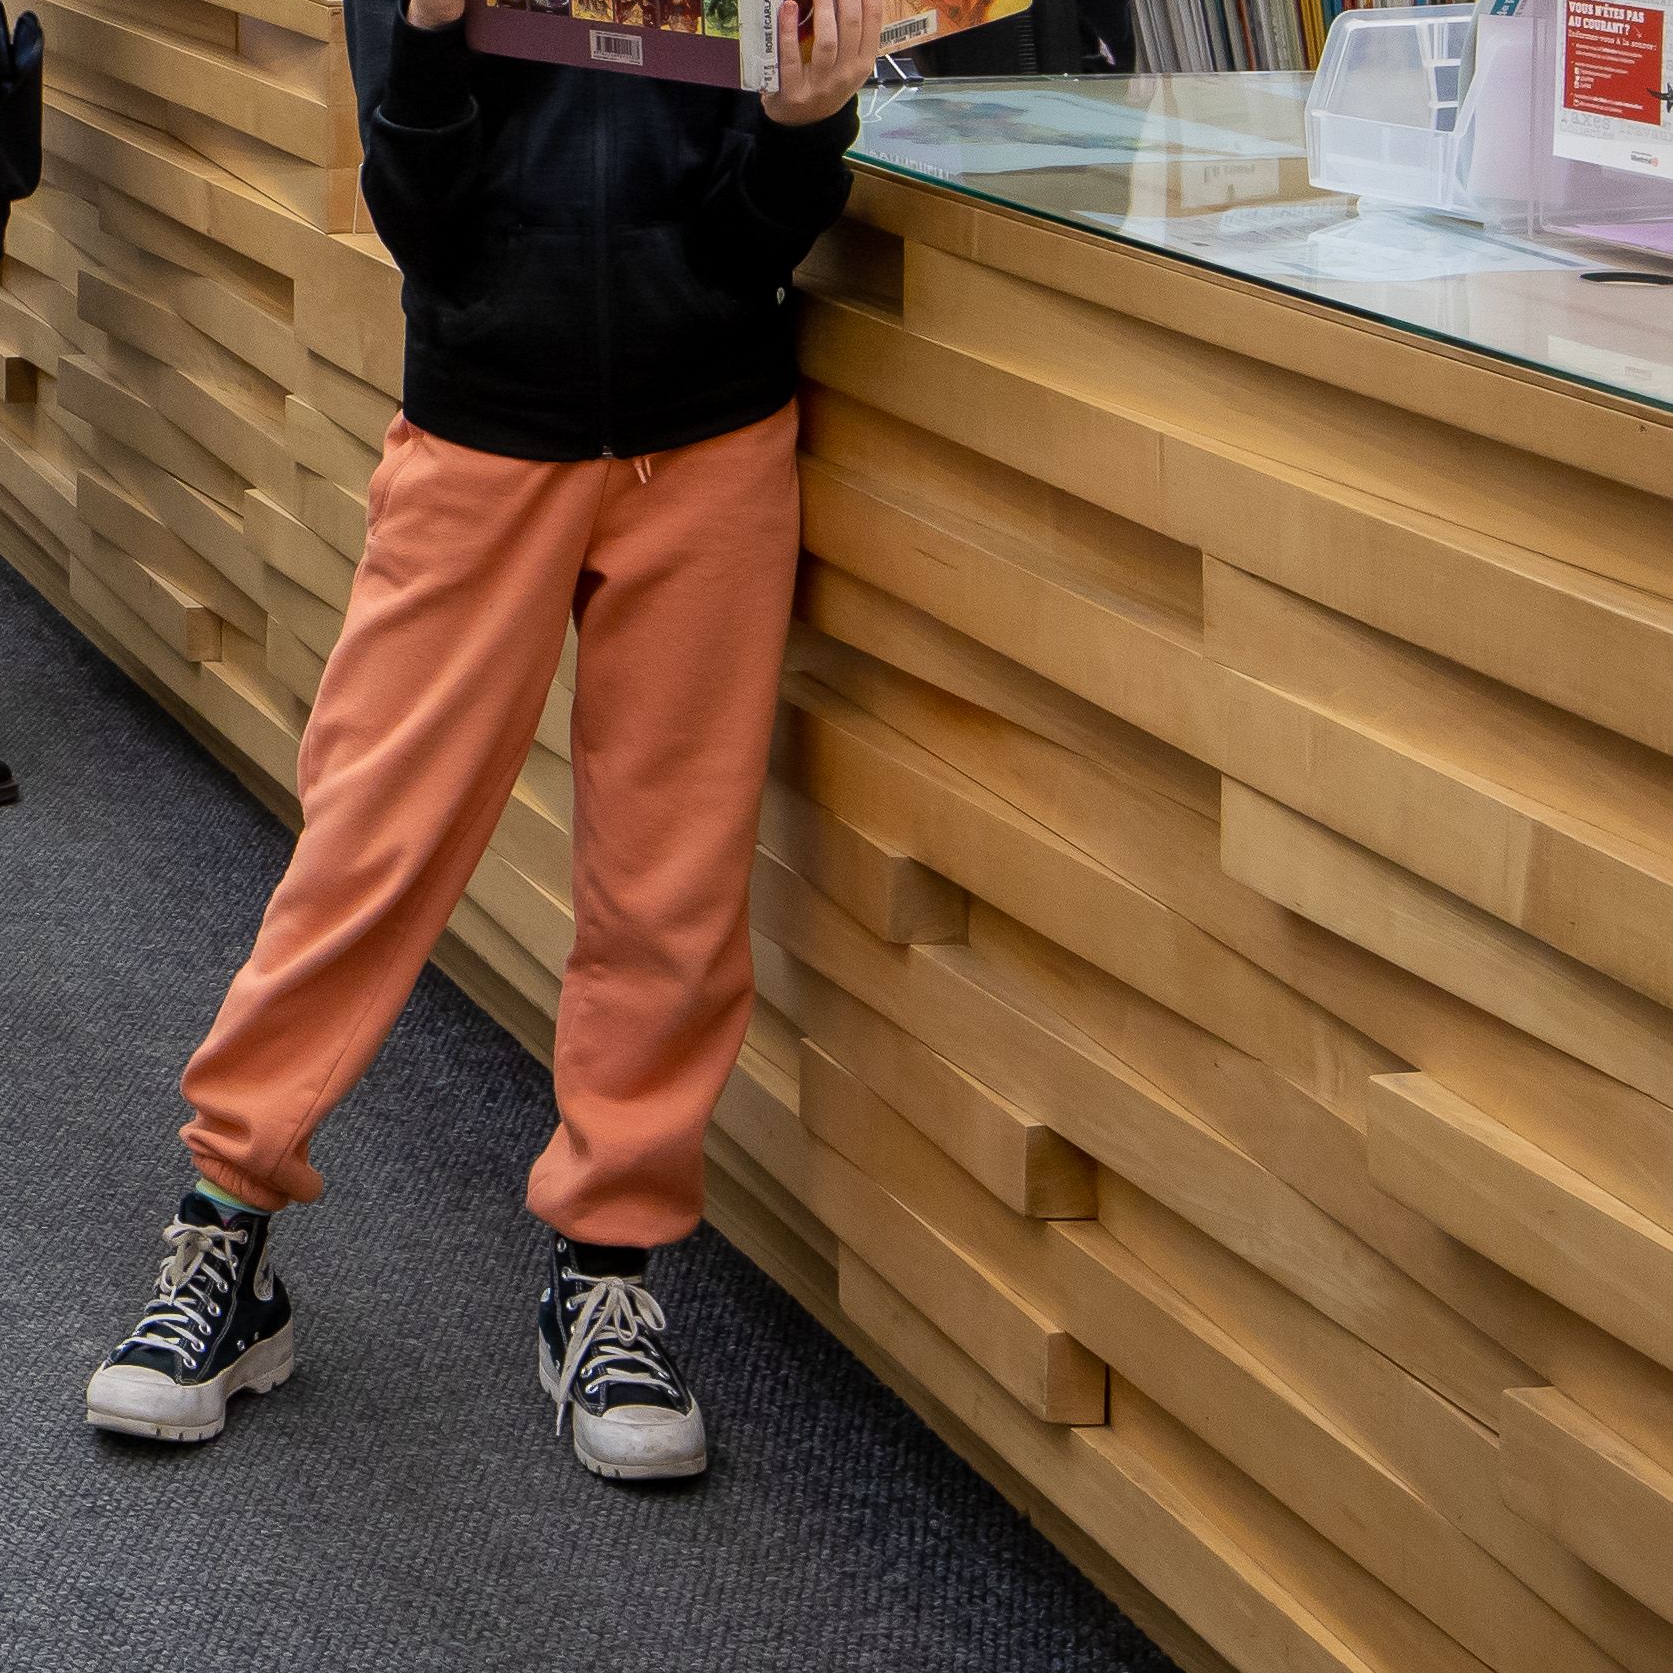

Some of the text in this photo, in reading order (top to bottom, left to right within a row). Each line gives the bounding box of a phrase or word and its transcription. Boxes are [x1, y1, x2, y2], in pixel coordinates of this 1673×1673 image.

[1567, 1, 1645, 23] VOUS N'ÊTES PAS
[1567, 16, 1582, 27] AU
[764, 30, 774, 54] ROSE
